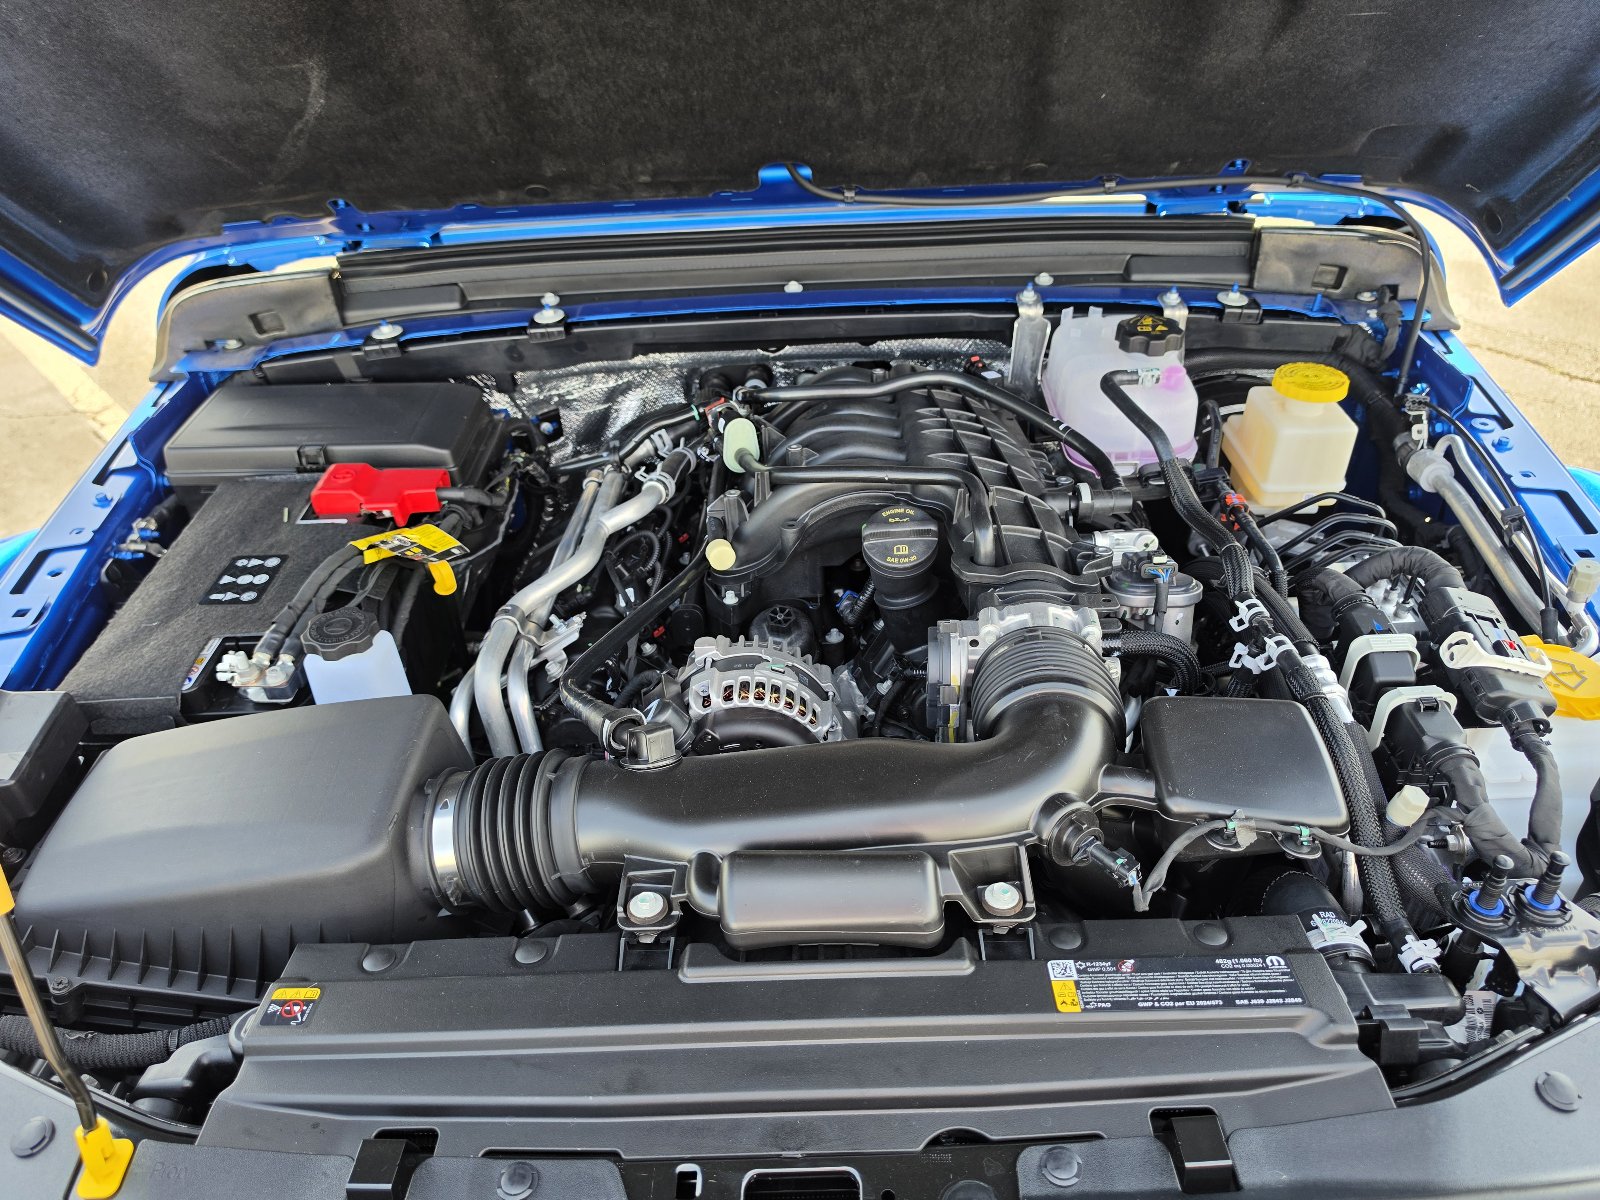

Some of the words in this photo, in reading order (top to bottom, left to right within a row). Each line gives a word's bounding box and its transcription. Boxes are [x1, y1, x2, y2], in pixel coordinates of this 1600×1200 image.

[881, 508, 905, 517] ENGINE
[905, 508, 915, 516] OIL
[899, 555, 917, 563] 0W-20
